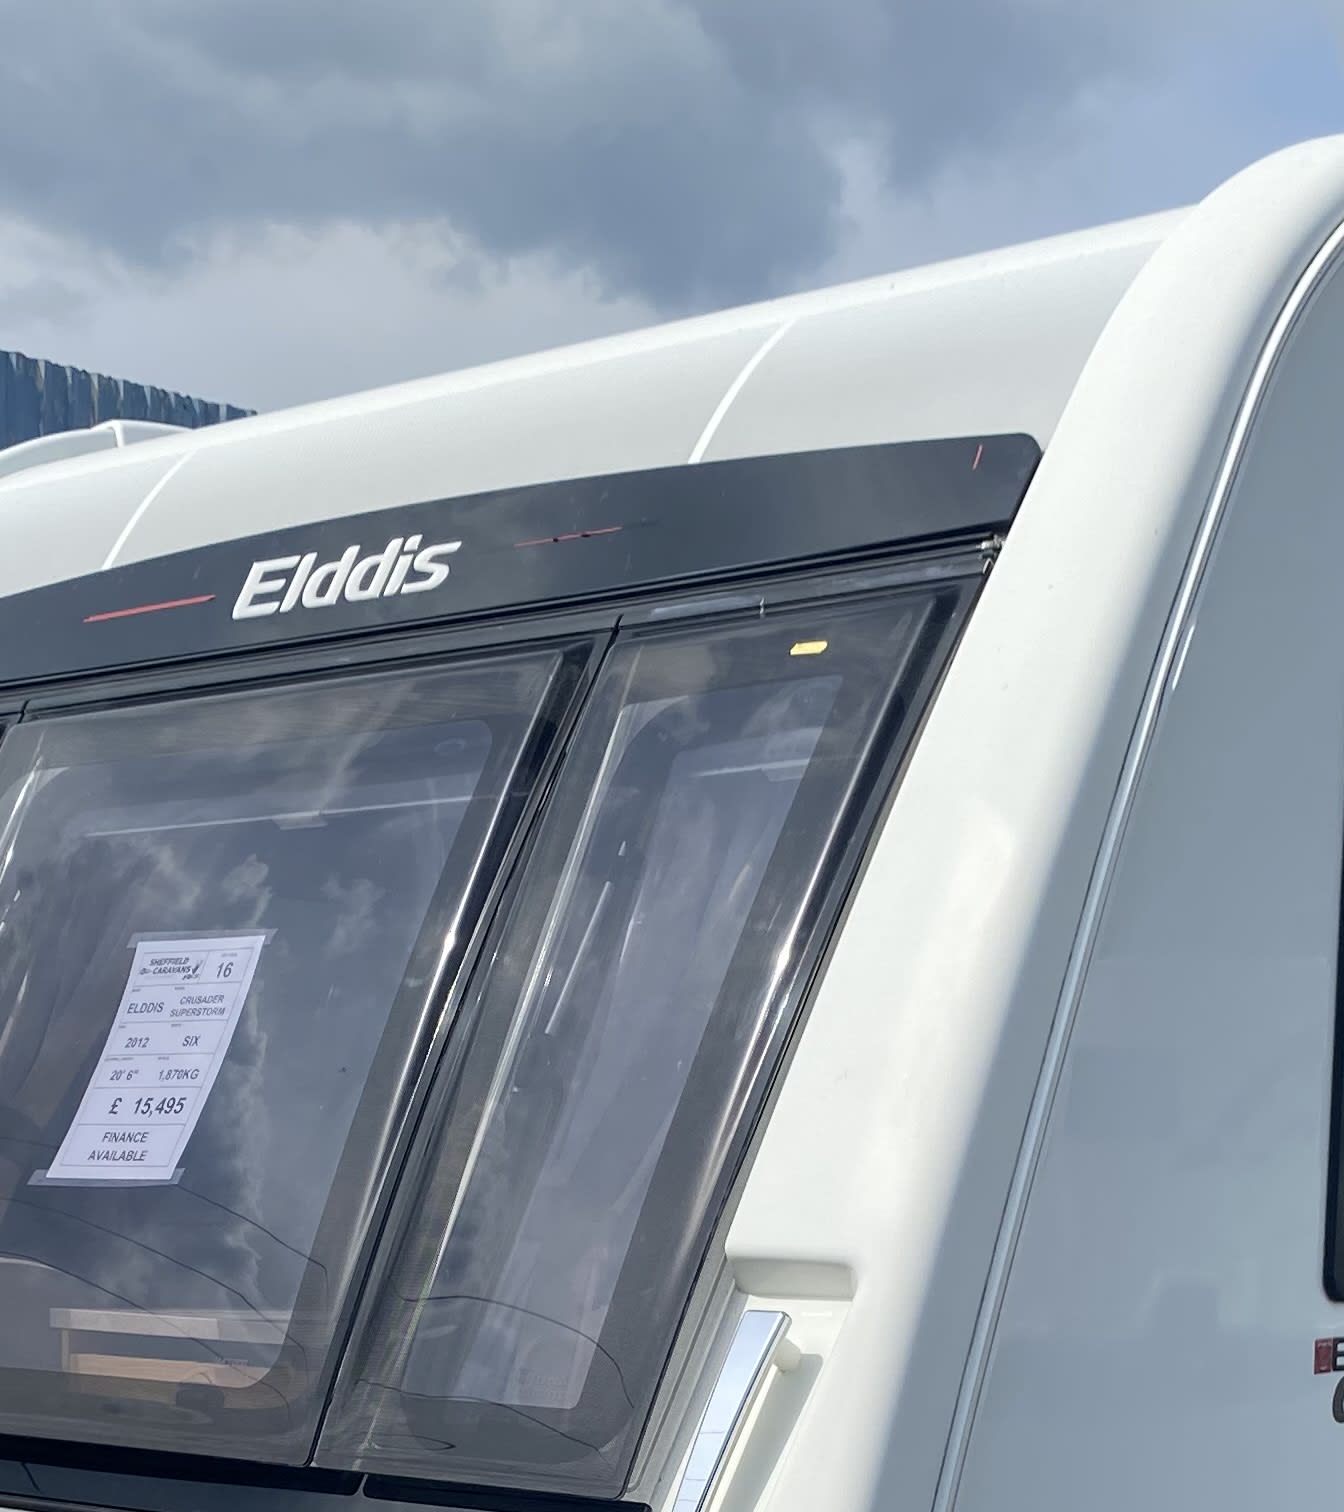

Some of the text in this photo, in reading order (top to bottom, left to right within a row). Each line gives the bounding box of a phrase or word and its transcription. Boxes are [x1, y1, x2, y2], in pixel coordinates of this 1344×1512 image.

[232, 534, 462, 620] Elddis
[149, 957, 190, 966] SHEFFIELD
[152, 966, 191, 975] CARAVANS
[216, 962, 234, 978] 16
[179, 995, 225, 1005] CRUSADER
[126, 1002, 165, 1014] ELDDIS
[169, 1007, 226, 1017] SUPERSTORM
[124, 1037, 150, 1048] 2012
[182, 1035, 201, 1047] SIX
[108, 1097, 187, 1118] £ 15,495
[102, 1131, 150, 1143] FINANCE
[87, 1150, 149, 1162] AVAILABLE
